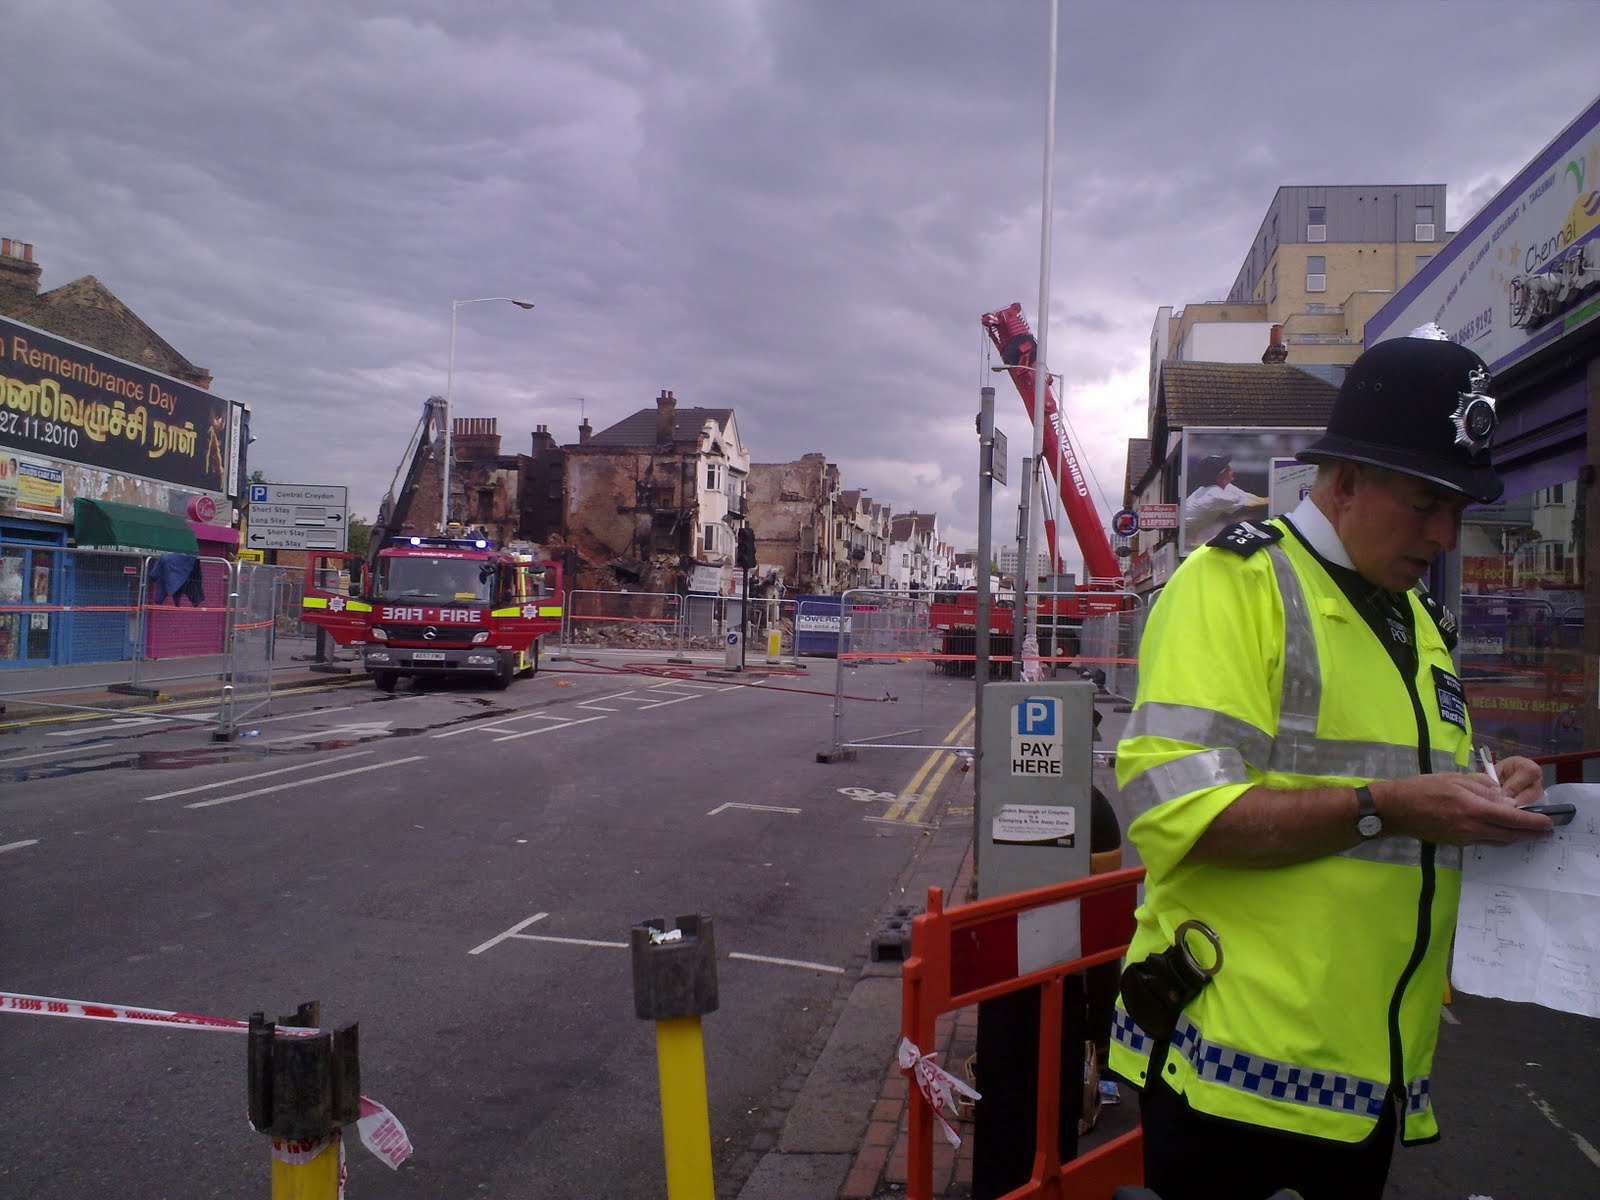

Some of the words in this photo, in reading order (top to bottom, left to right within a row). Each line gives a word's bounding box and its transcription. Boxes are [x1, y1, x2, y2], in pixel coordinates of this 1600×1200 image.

[1525, 219, 1577, 274] Chennai
[1475, 307, 1492, 335] 9192
[14, 336, 145, 401] Remembrance
[149, 382, 178, 416] Day
[0, 411, 79, 449] 27.11.2010
[254, 487, 266, 501] P
[276, 491, 303, 499] Central
[305, 492, 335, 501] Croydon
[274, 507, 290, 515] Stay
[251, 517, 269, 525] Long
[270, 517, 286, 525] Stay
[1147, 519, 1176, 527] LAPTOPS
[289, 530, 305, 538] Stay
[265, 540, 282, 548] Long
[285, 540, 302, 548] Stay
[440, 609, 481, 623] FIRE
[799, 615, 850, 623] POWERDY
[1498, 698, 1530, 711] FAMILY
[1026, 702, 1048, 732] P
[1441, 709, 1459, 724] POLICE
[1021, 743, 1053, 757] PAY
[1013, 759, 1061, 774] HERE
